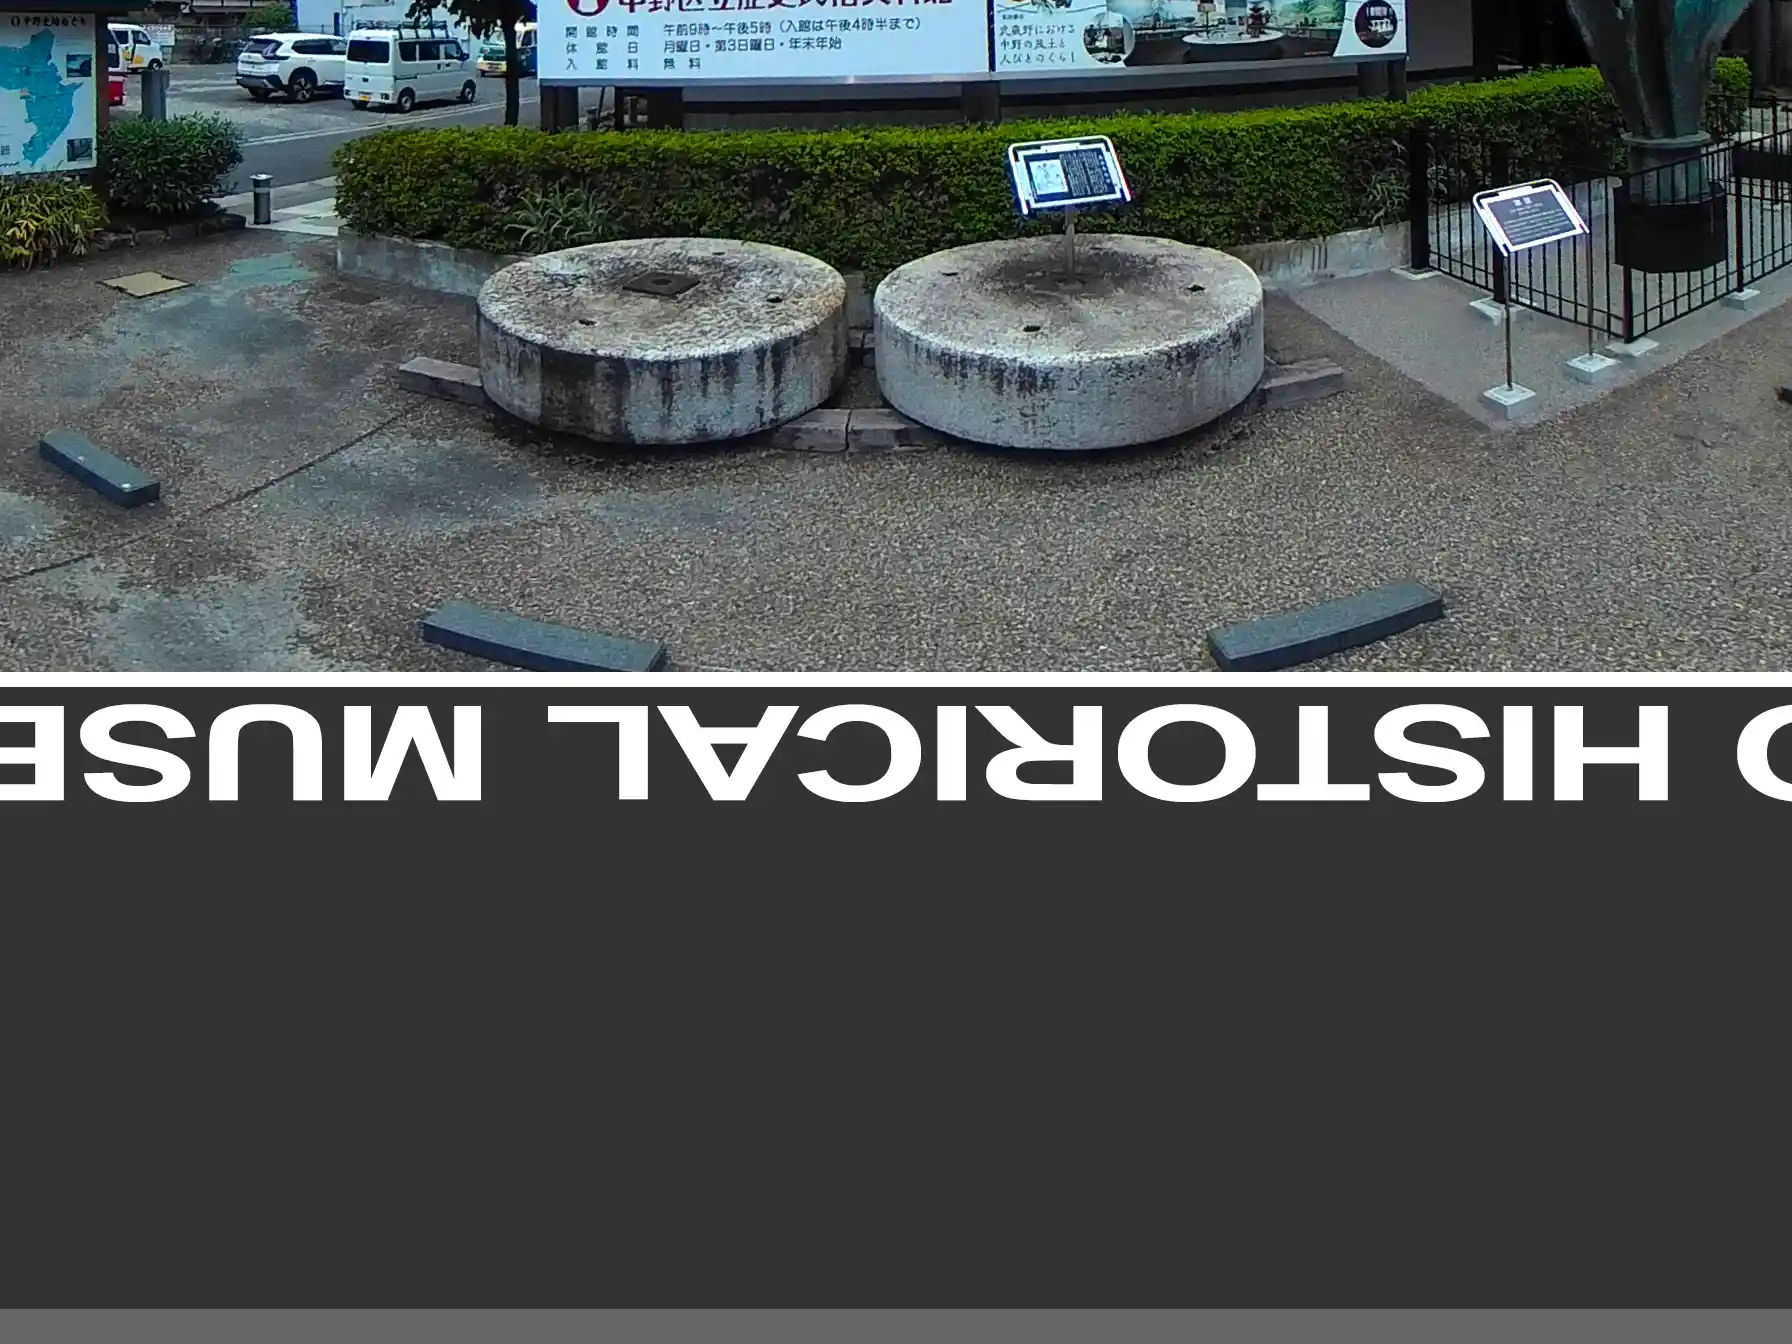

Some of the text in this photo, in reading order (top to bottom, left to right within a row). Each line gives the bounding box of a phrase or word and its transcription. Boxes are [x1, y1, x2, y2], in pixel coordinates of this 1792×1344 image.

[566, 57, 701, 71] 入館料 無料
